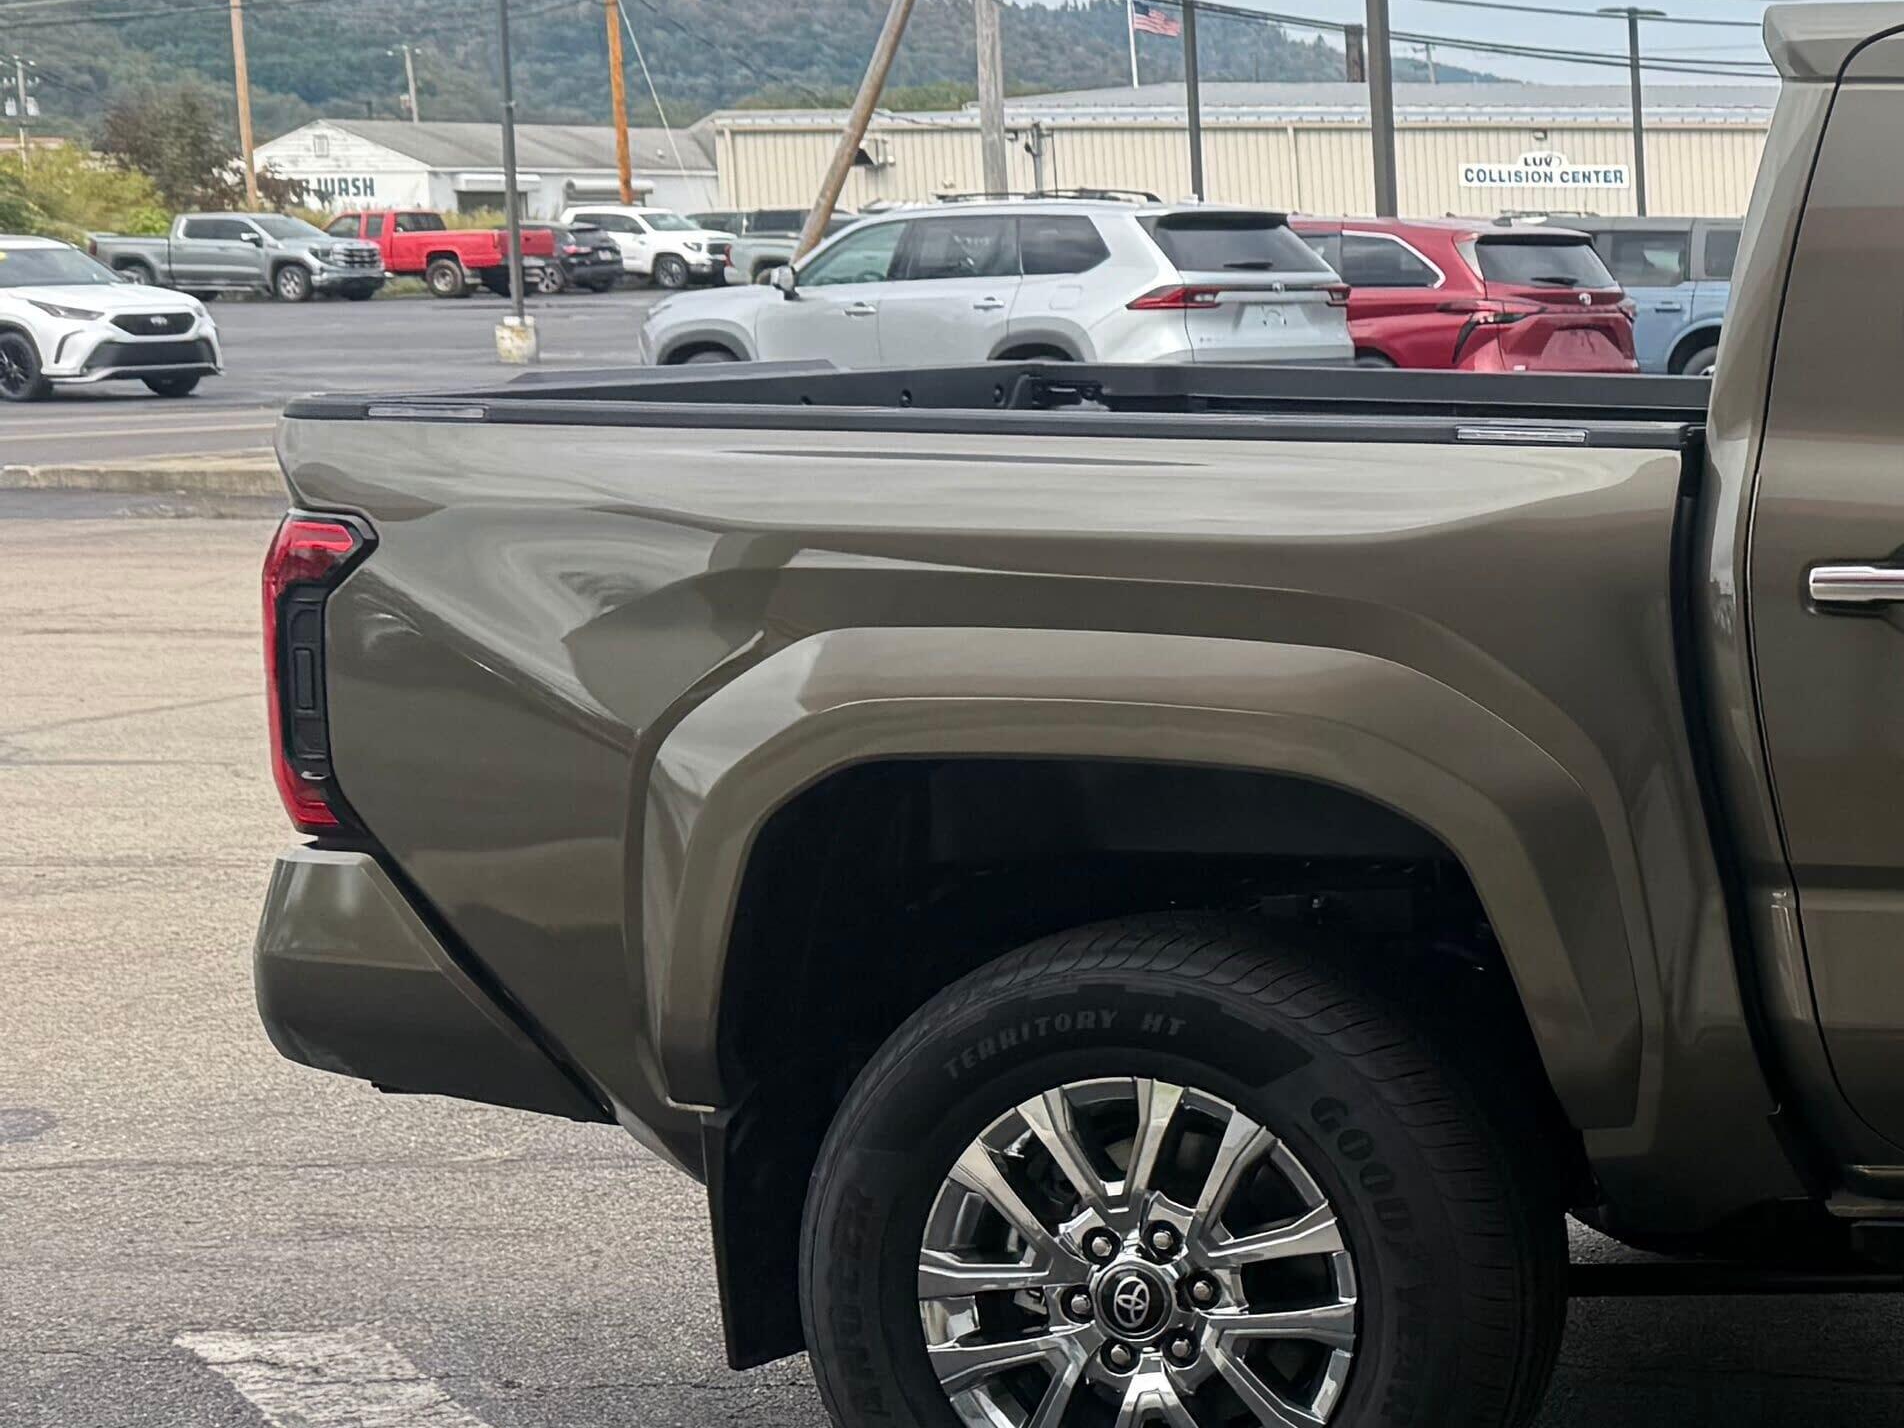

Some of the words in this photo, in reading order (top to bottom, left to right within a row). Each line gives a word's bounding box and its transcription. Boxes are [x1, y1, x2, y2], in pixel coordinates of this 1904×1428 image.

[1464, 168, 1554, 184] COLLISION
[1559, 169, 1624, 184] CENTER
[316, 177, 375, 197] WASH
[941, 1007, 1118, 1080] TERRITORY
[1139, 1012, 1188, 1037] HT
